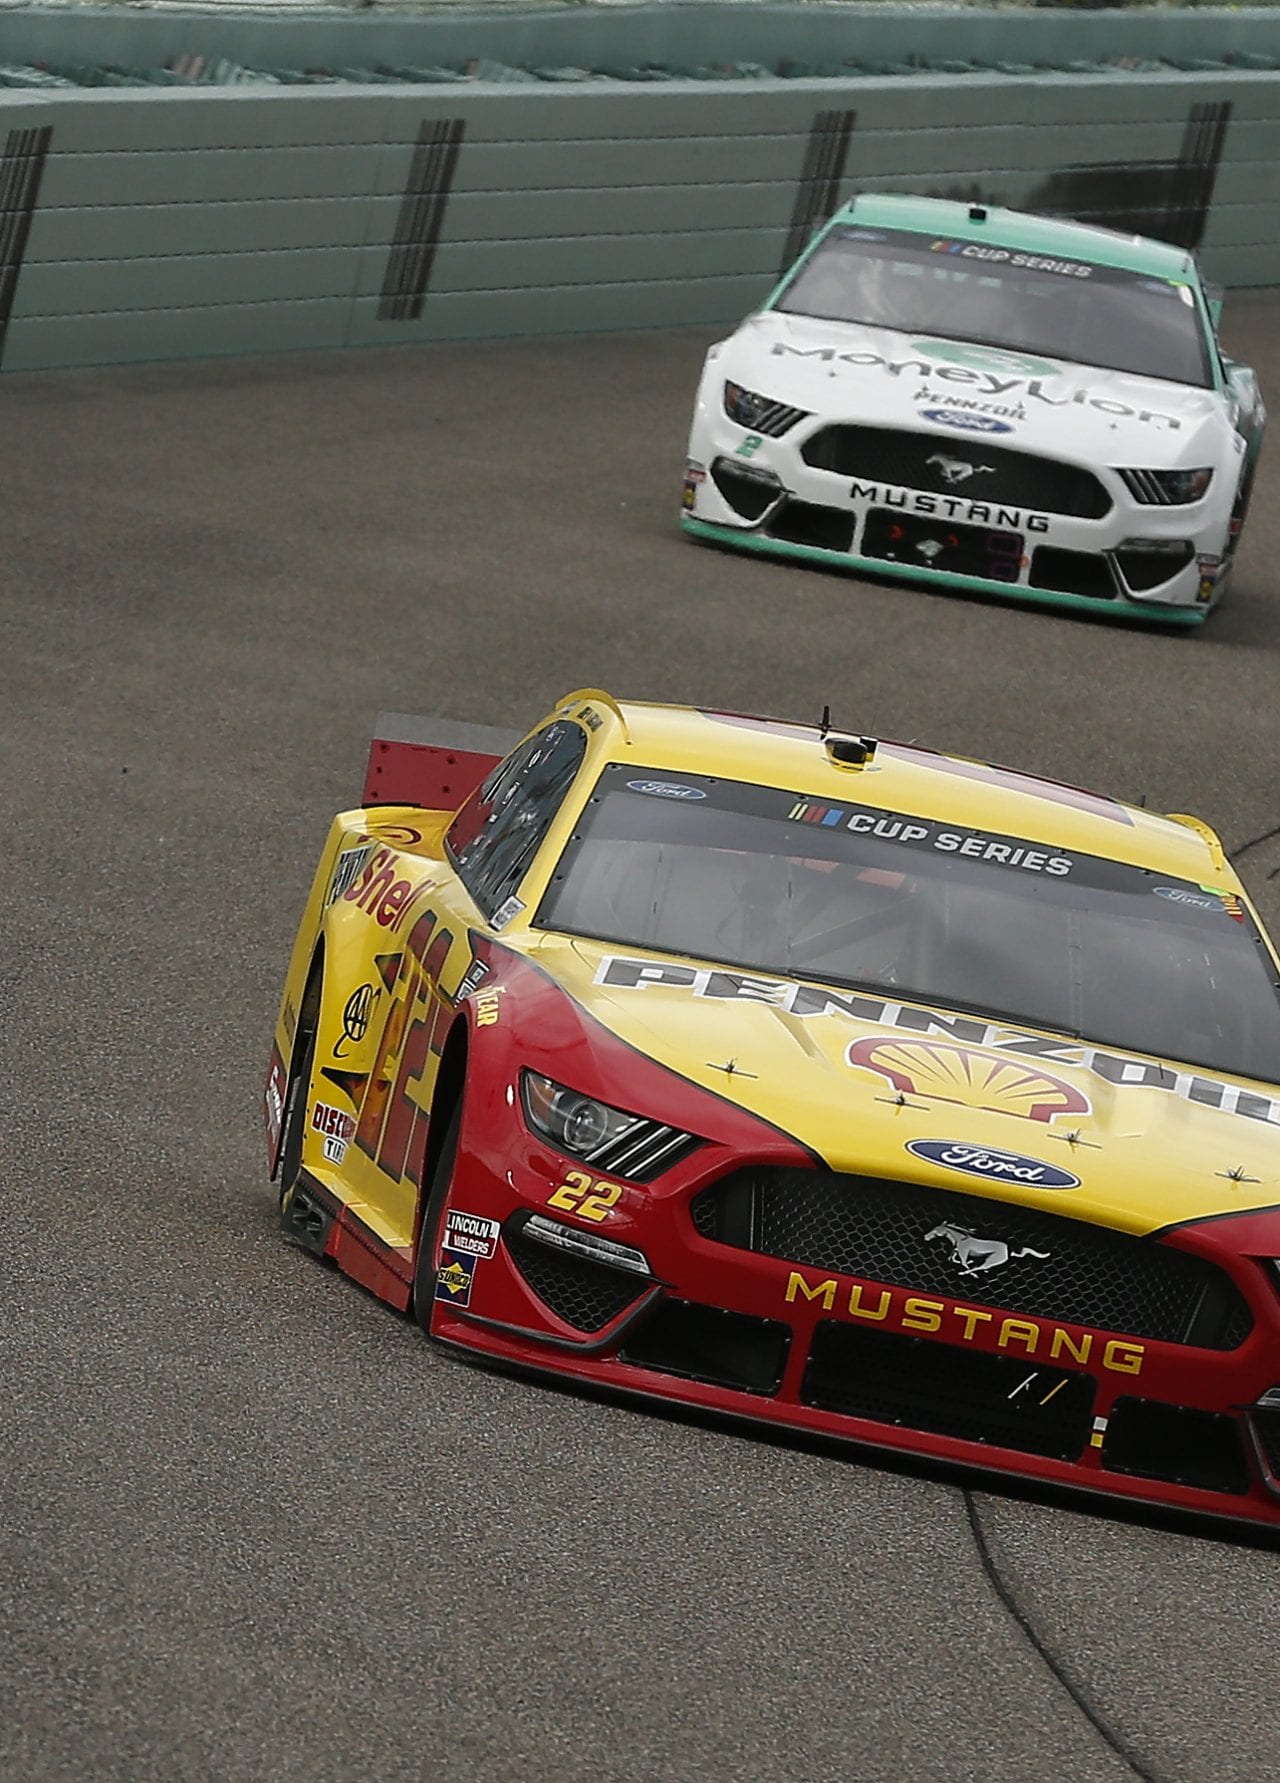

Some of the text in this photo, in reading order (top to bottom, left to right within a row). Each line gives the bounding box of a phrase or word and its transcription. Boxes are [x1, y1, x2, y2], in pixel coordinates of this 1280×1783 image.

[962, 245, 1092, 278] CUP SERIES
[771, 342, 1182, 430] MoneyLion
[735, 435, 763, 458] 2
[850, 483, 1050, 533] MUSTANG
[638, 781, 695, 798] Ford
[847, 814, 1074, 876] CUP SERIES
[1165, 888, 1213, 908] Ford
[938, 1143, 1048, 1184] Ford
[547, 1170, 623, 1222] 22
[446, 1213, 490, 1238] LINCOLN
[453, 1234, 490, 1254] WELDERS
[784, 1271, 1146, 1376] MUSTANG
